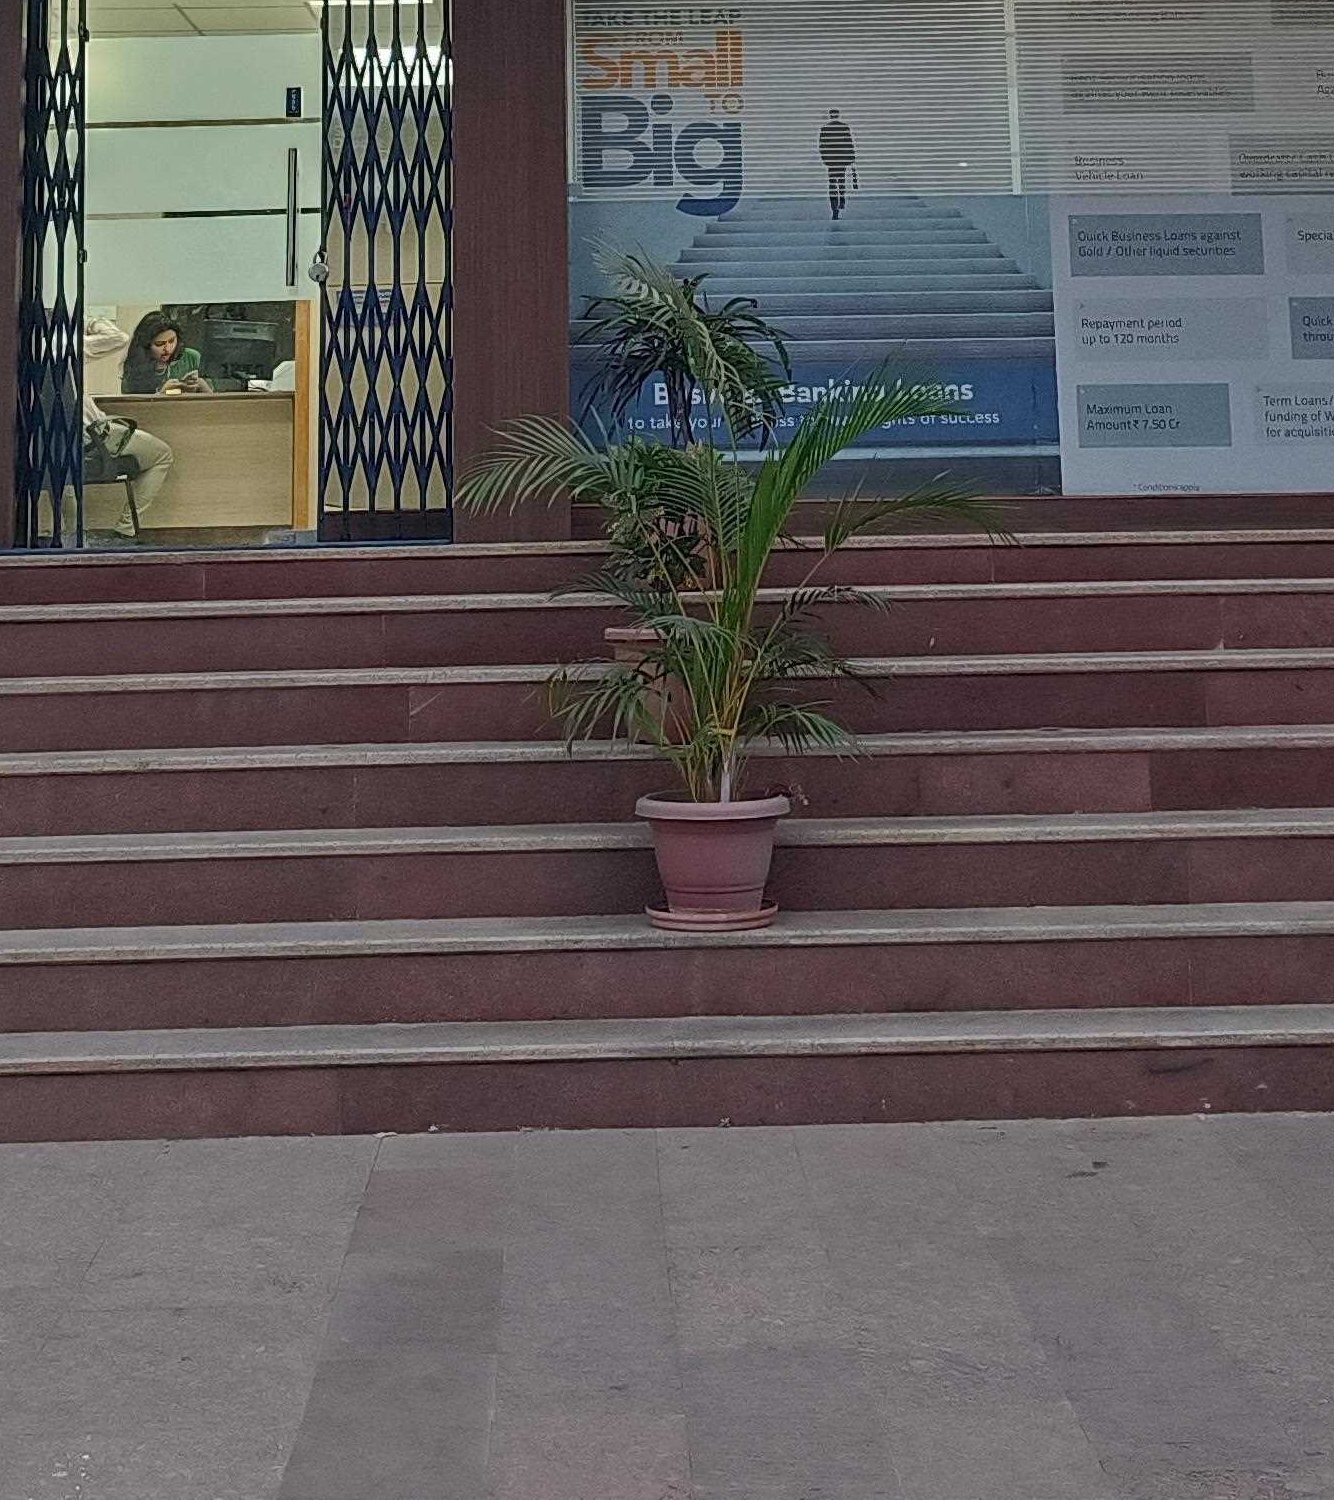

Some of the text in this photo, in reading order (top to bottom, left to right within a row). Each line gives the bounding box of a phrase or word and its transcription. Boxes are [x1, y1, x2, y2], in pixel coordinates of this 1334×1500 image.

[580, 30, 744, 89] Small
[581, 94, 744, 217] Big
[1077, 229, 1242, 243] Quick Business Loans against
[1078, 246, 1104, 258] Gold
[1115, 245, 1146, 257] Other
[1149, 245, 1180, 259] liquid
[1081, 317, 1182, 331] Repayment period
[1302, 315, 1333, 328] Quick
[1082, 333, 1180, 346] up to 120 months
[1263, 395, 1291, 406] Term
[1086, 403, 1173, 415] Maximum Loan
[627, 416, 645, 430] to
[1142, 418, 1181, 430] 7.50 Cr
[1264, 411, 1308, 424] funding
[1310, 410, 1323, 421] of
[1265, 426, 1281, 438] for
